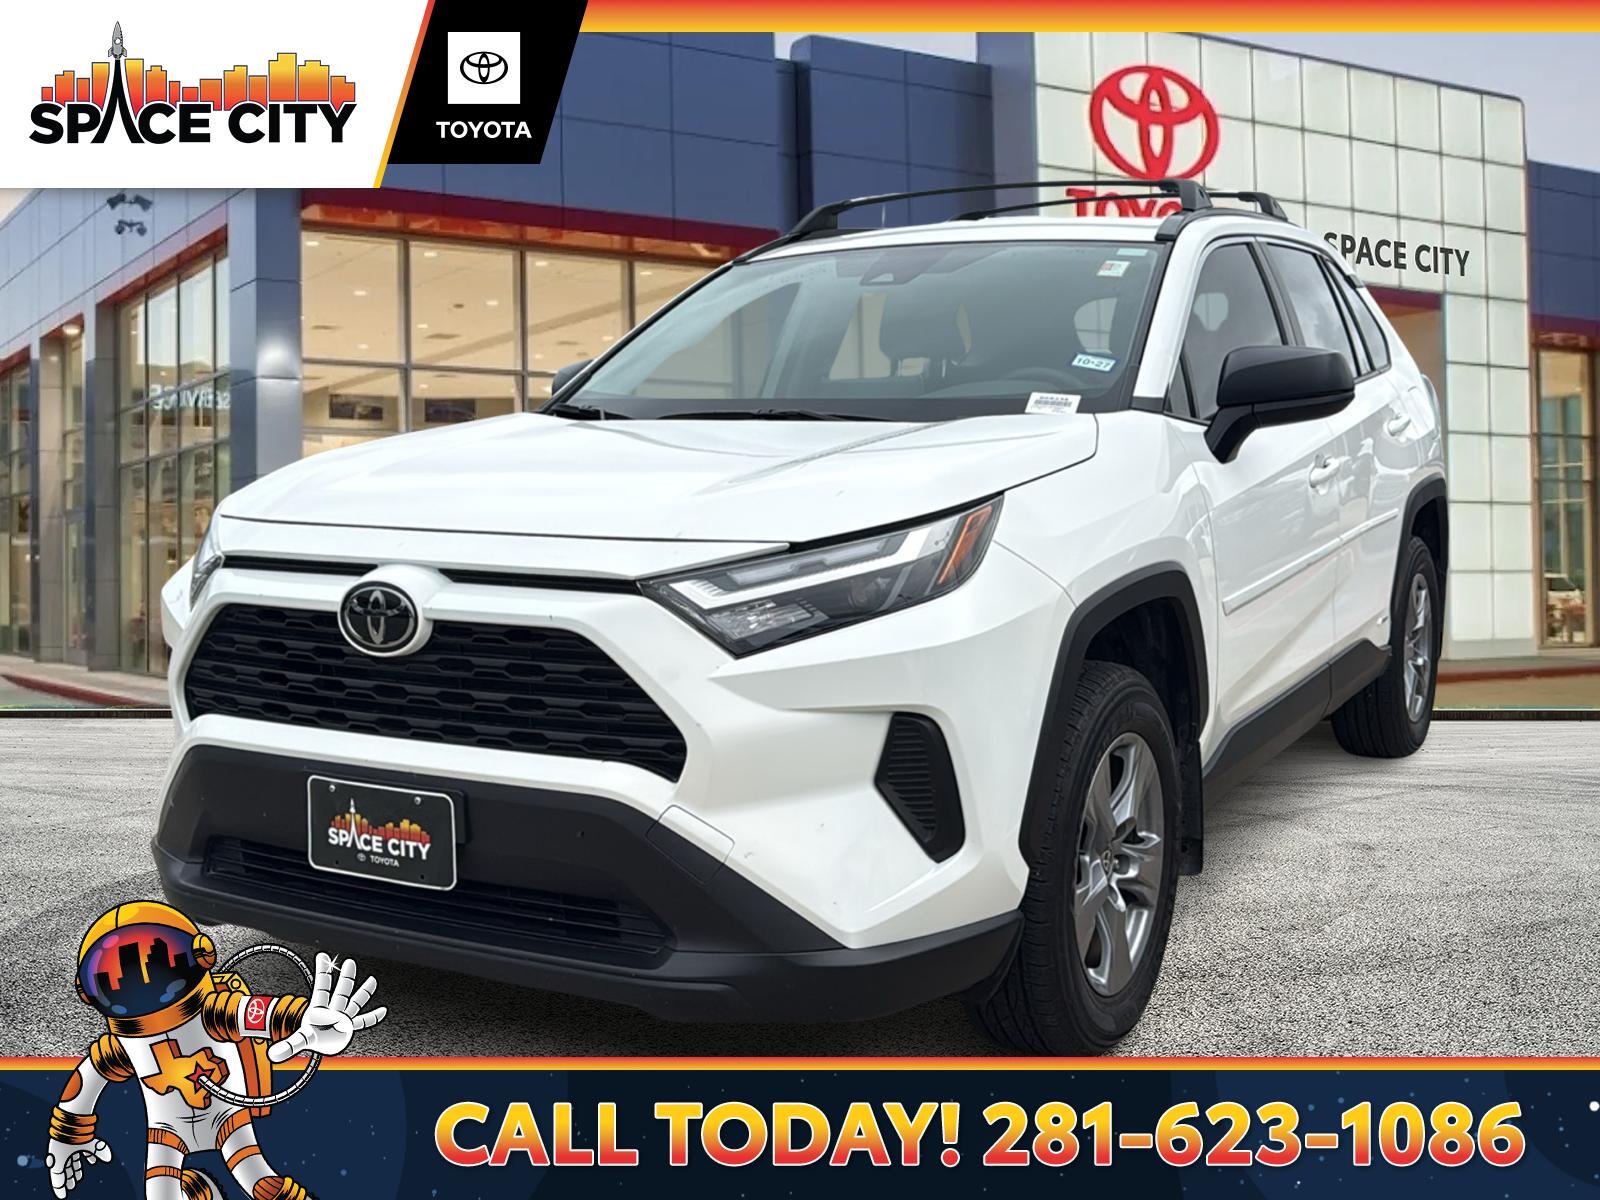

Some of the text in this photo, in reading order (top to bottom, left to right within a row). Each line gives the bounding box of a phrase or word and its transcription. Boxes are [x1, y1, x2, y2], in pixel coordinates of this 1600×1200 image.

[1415, 244, 1470, 276] CITY
[328, 815, 431, 860] SPACE CITY
[369, 855, 400, 868] TOYOTA
